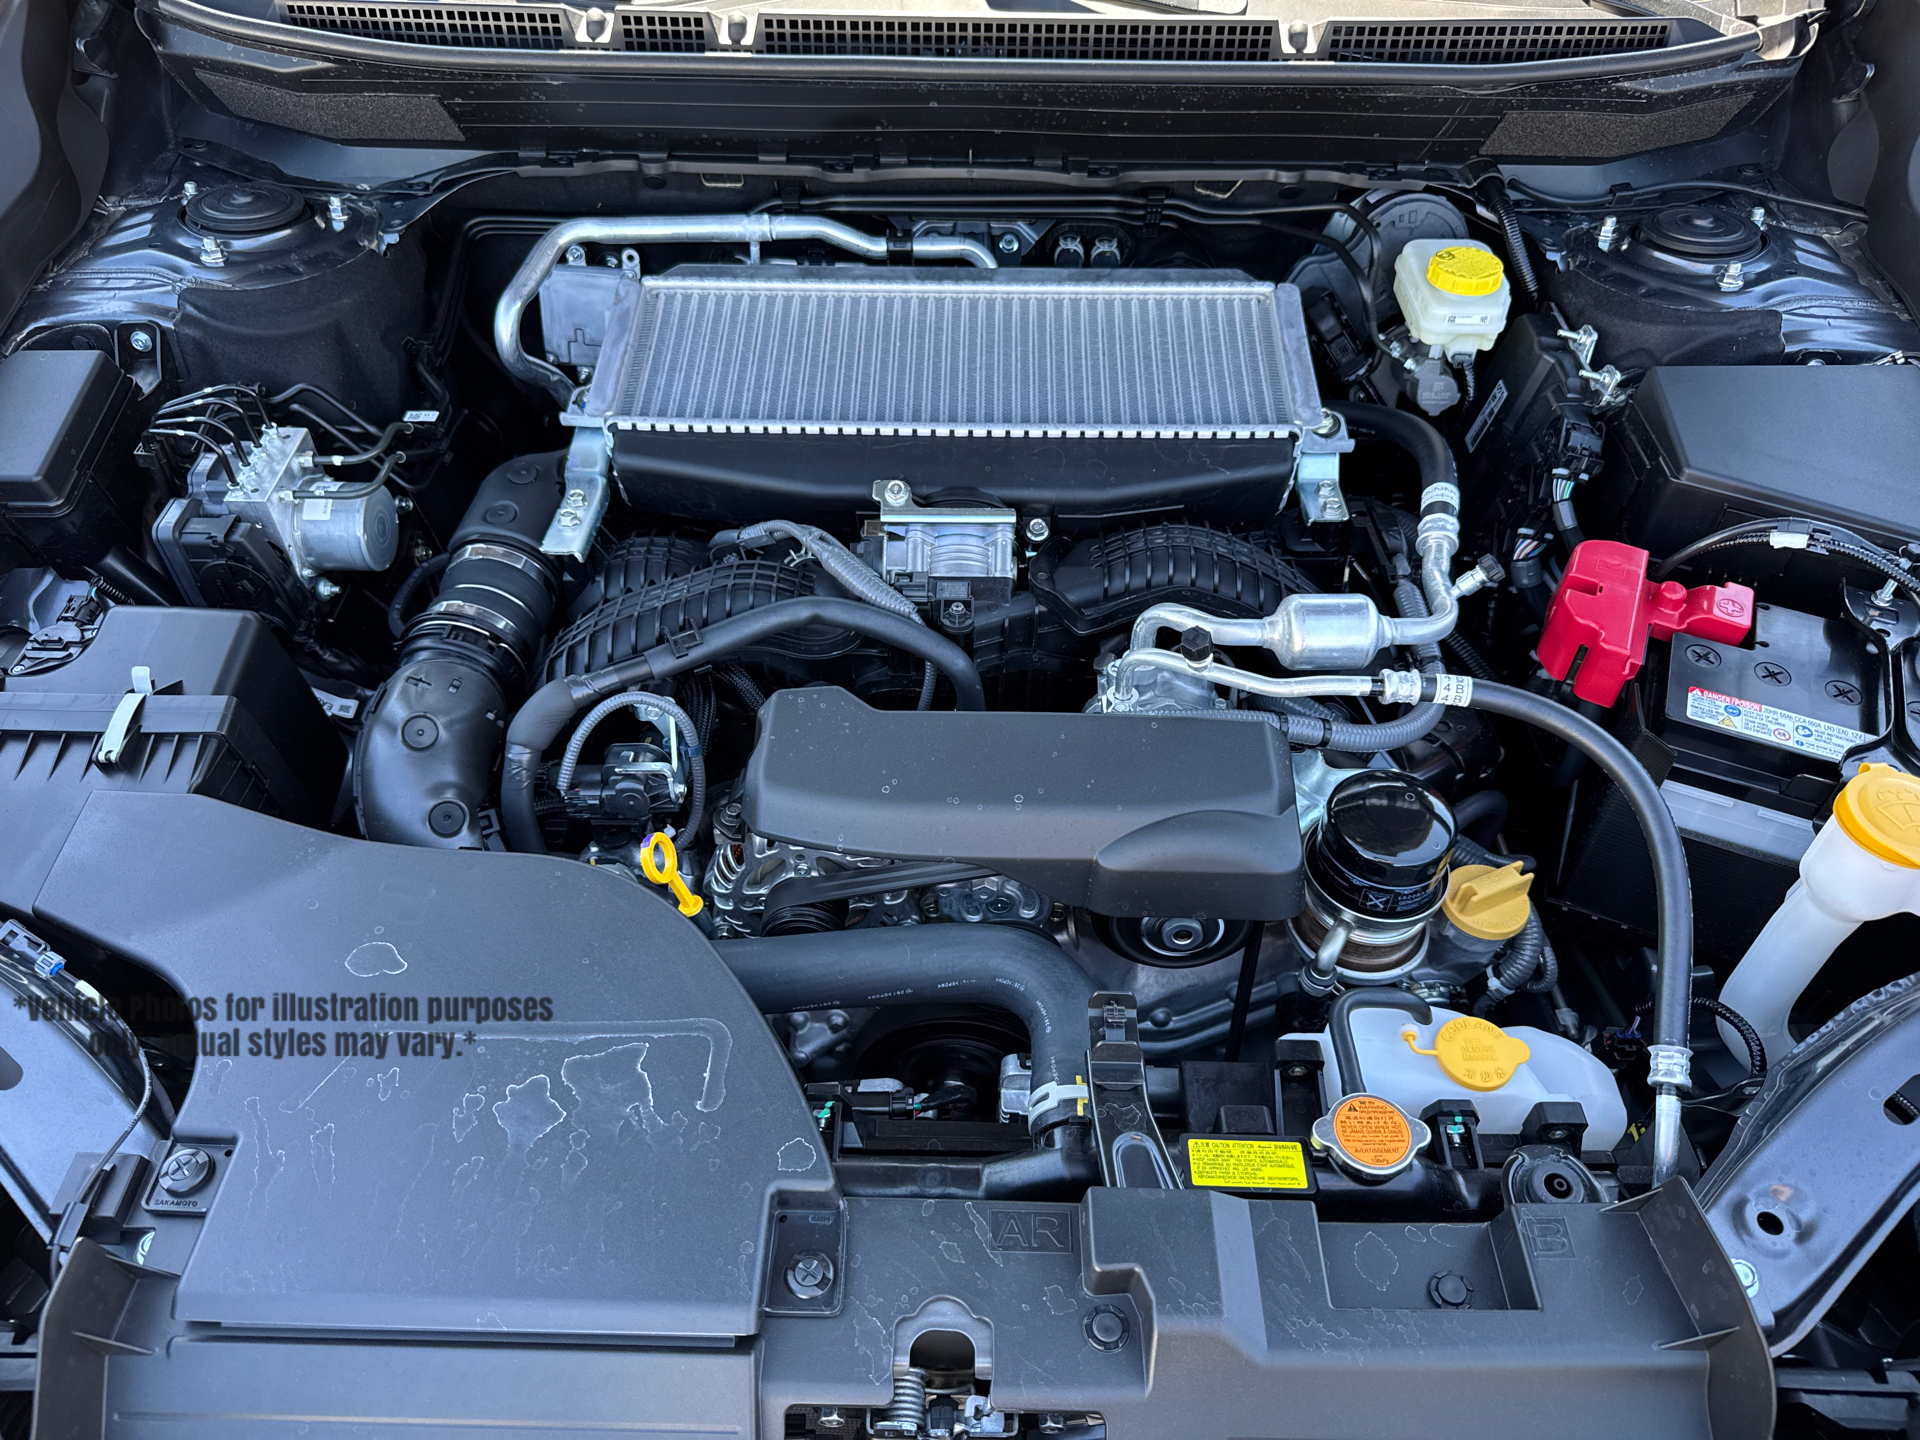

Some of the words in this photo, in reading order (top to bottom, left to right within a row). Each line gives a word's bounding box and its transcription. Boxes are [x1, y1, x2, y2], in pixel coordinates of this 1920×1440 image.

[1703, 690, 1731, 704] DANGER
[1735, 699, 1760, 712] POISON
[1763, 707, 1778, 717] 20HR
[1794, 716, 1807, 725] CCA
[1440, 1019, 1504, 1042] COOLANT
[1462, 1053, 1497, 1062] MANUAL
[154, 1199, 198, 1207] SAKAMOTO
[996, 1213, 1064, 1248] AR
[1528, 1219, 1569, 1255] B
